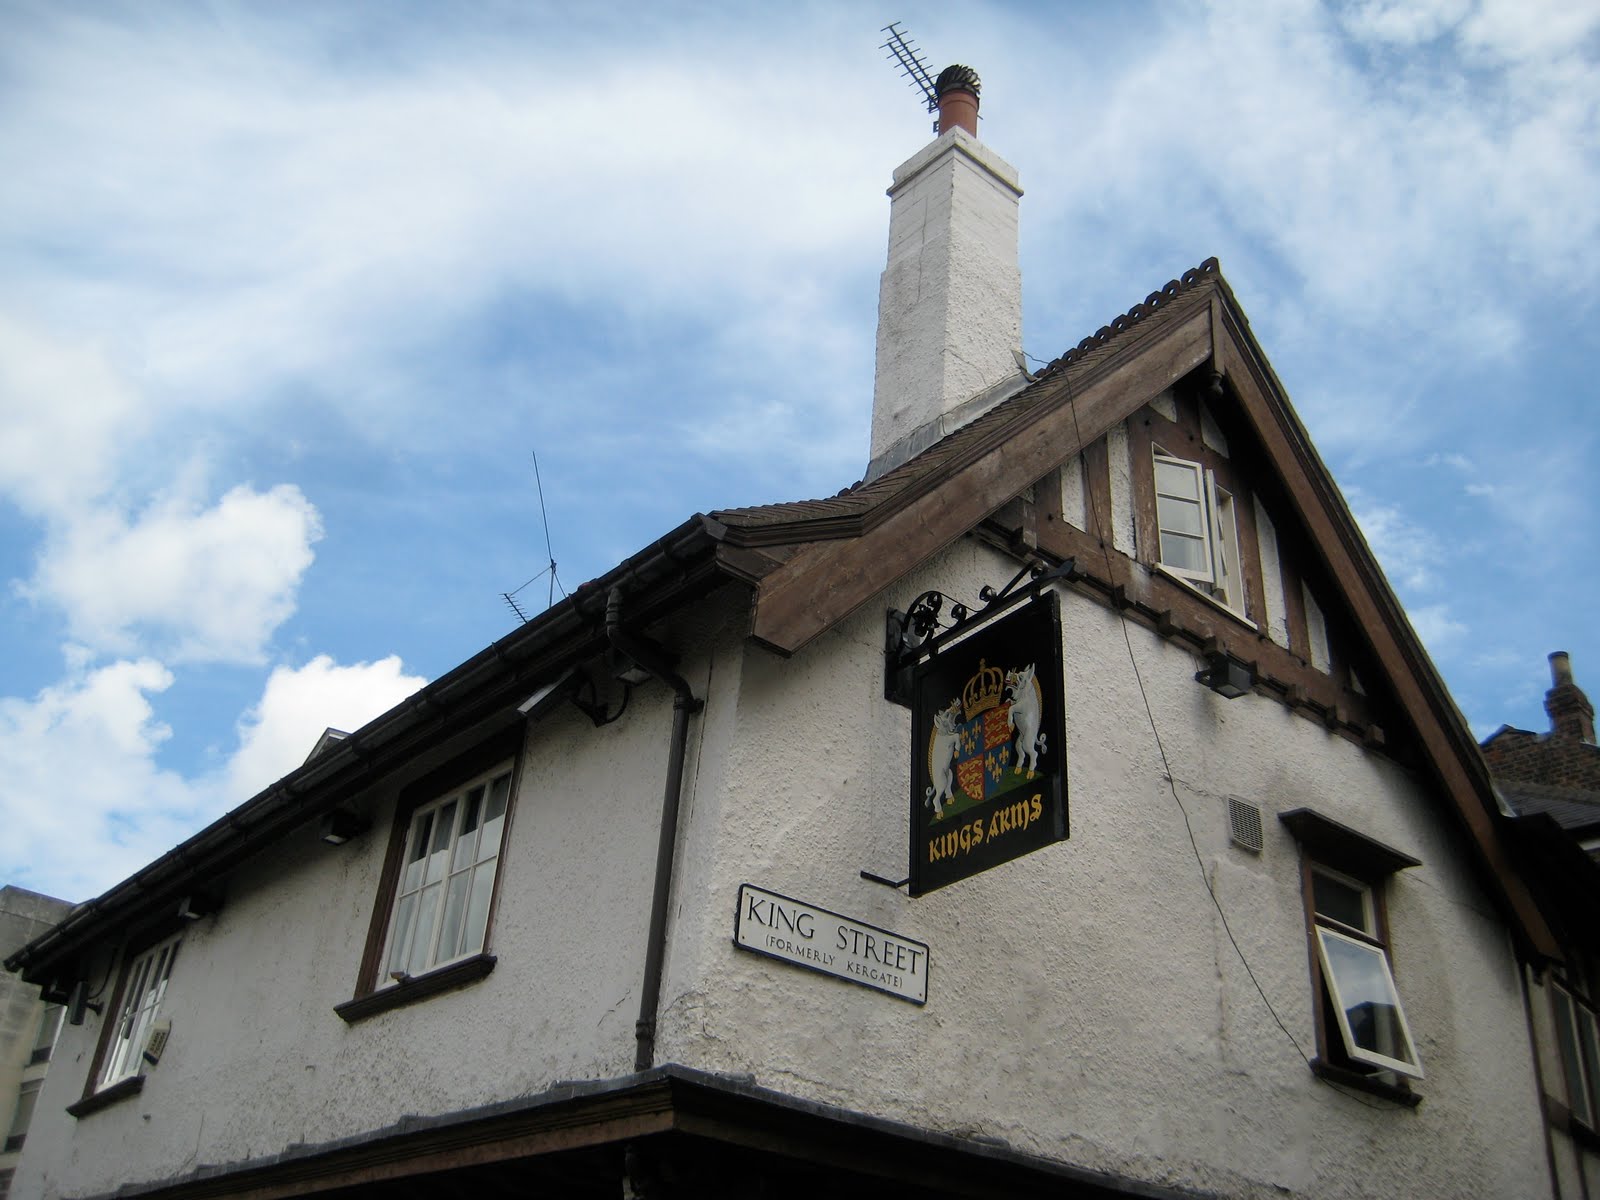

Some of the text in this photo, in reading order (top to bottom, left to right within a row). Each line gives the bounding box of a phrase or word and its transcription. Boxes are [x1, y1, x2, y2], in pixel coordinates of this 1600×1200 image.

[747, 895, 922, 975] KING STREET
[765, 933, 903, 988] (FORMERLY KERGATE)
